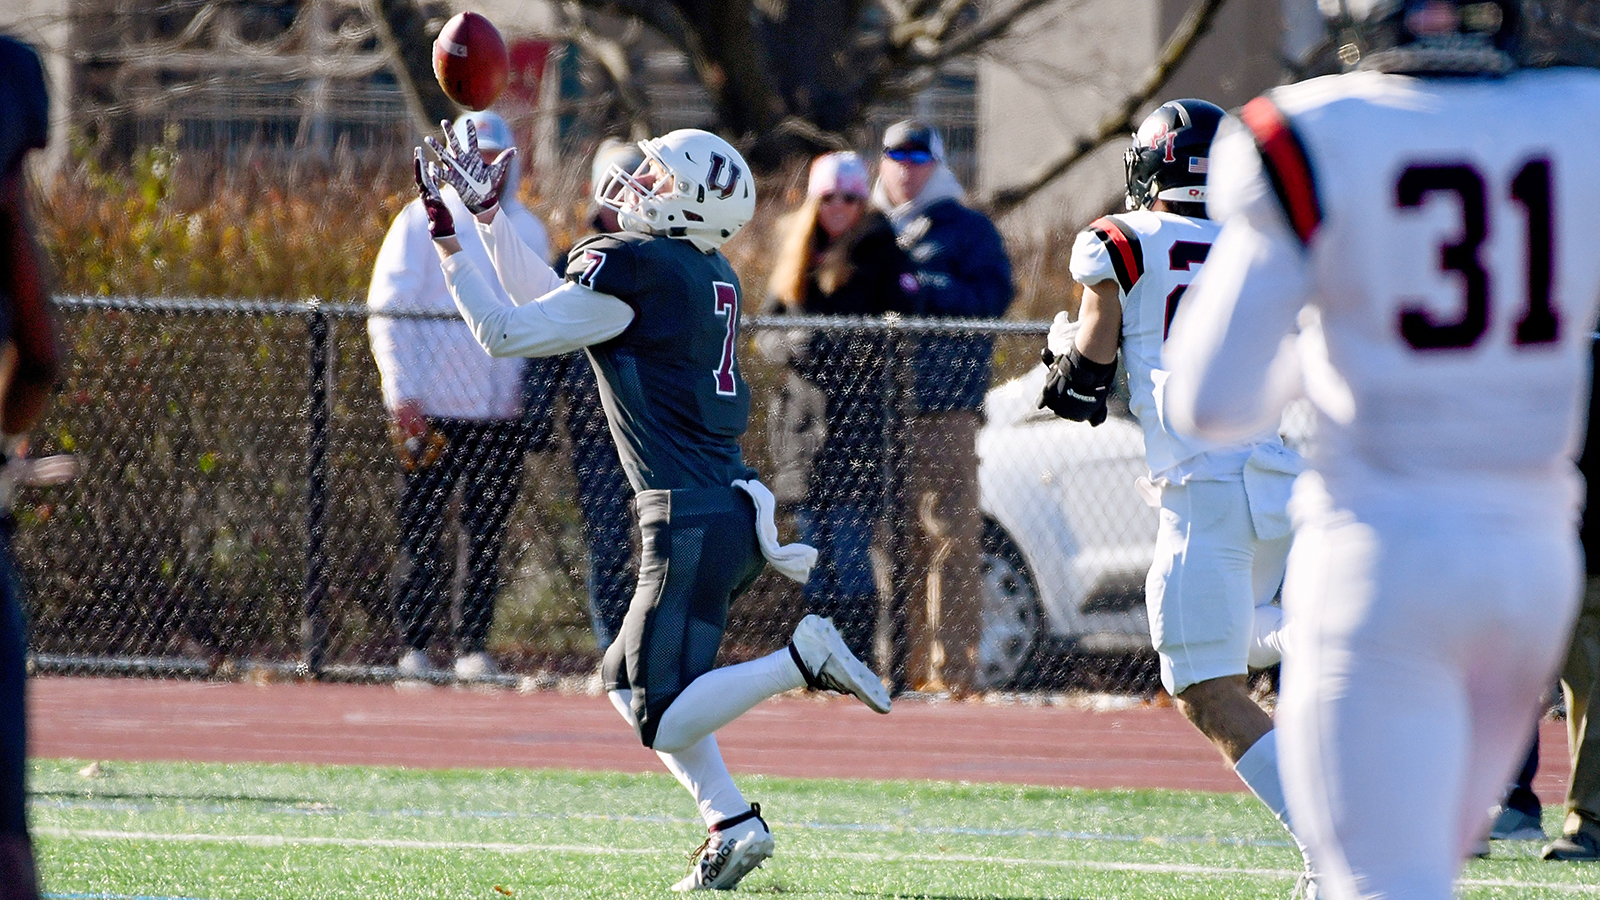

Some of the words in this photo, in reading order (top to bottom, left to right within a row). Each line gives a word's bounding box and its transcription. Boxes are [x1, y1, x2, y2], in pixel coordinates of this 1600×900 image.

[707, 151, 742, 200] U
[578, 250, 607, 291] 7
[1396, 160, 1561, 350] 31
[712, 281, 738, 396] 7
[702, 838, 738, 887] adidas
